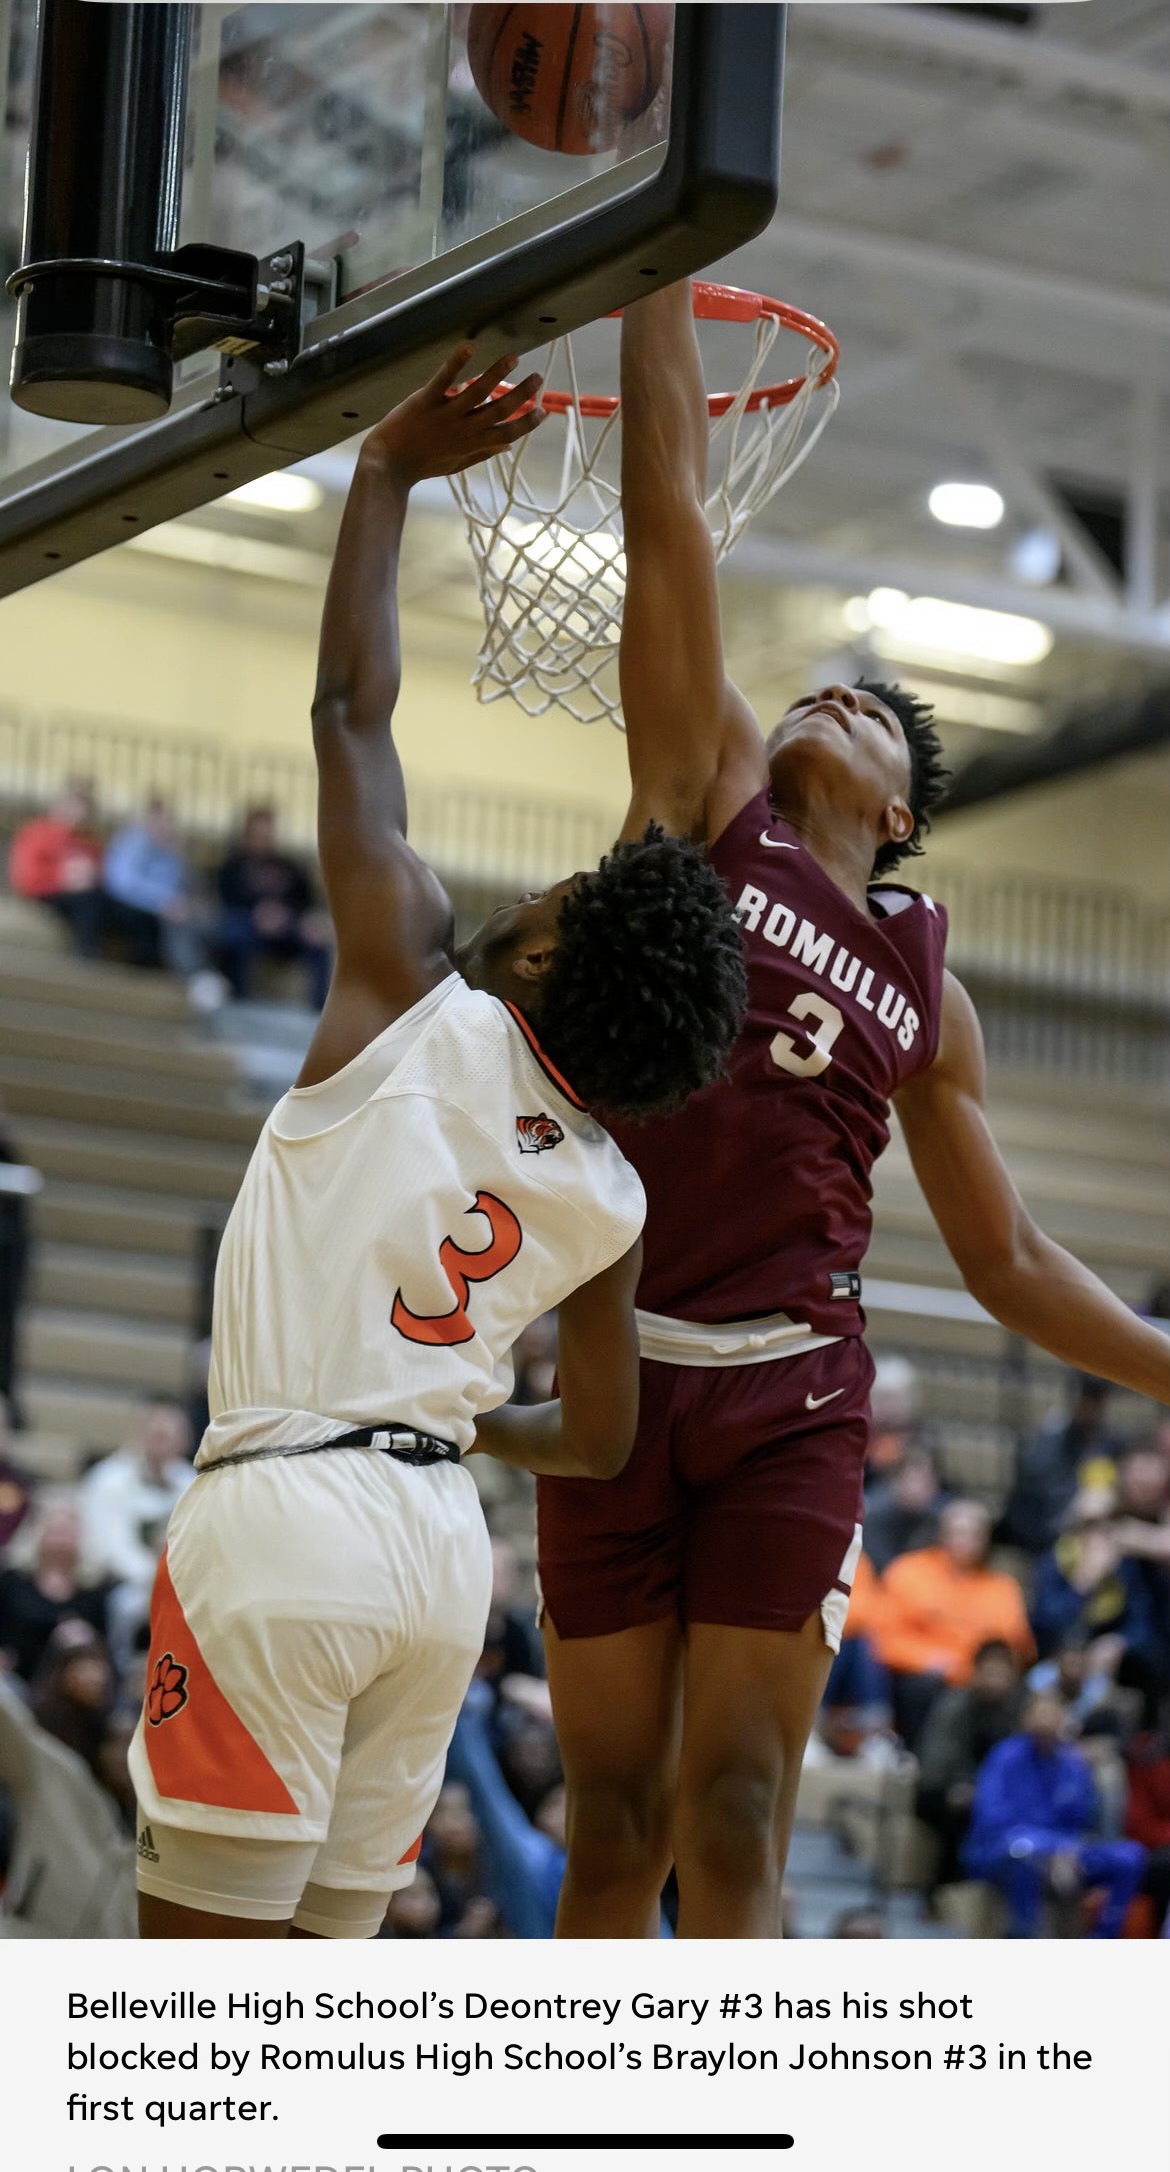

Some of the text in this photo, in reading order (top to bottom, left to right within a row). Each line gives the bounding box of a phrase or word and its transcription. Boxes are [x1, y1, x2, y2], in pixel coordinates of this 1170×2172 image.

[730, 884, 920, 1051] ROMULUS
[769, 992, 845, 1078] 3
[391, 1190, 522, 1347] 3
